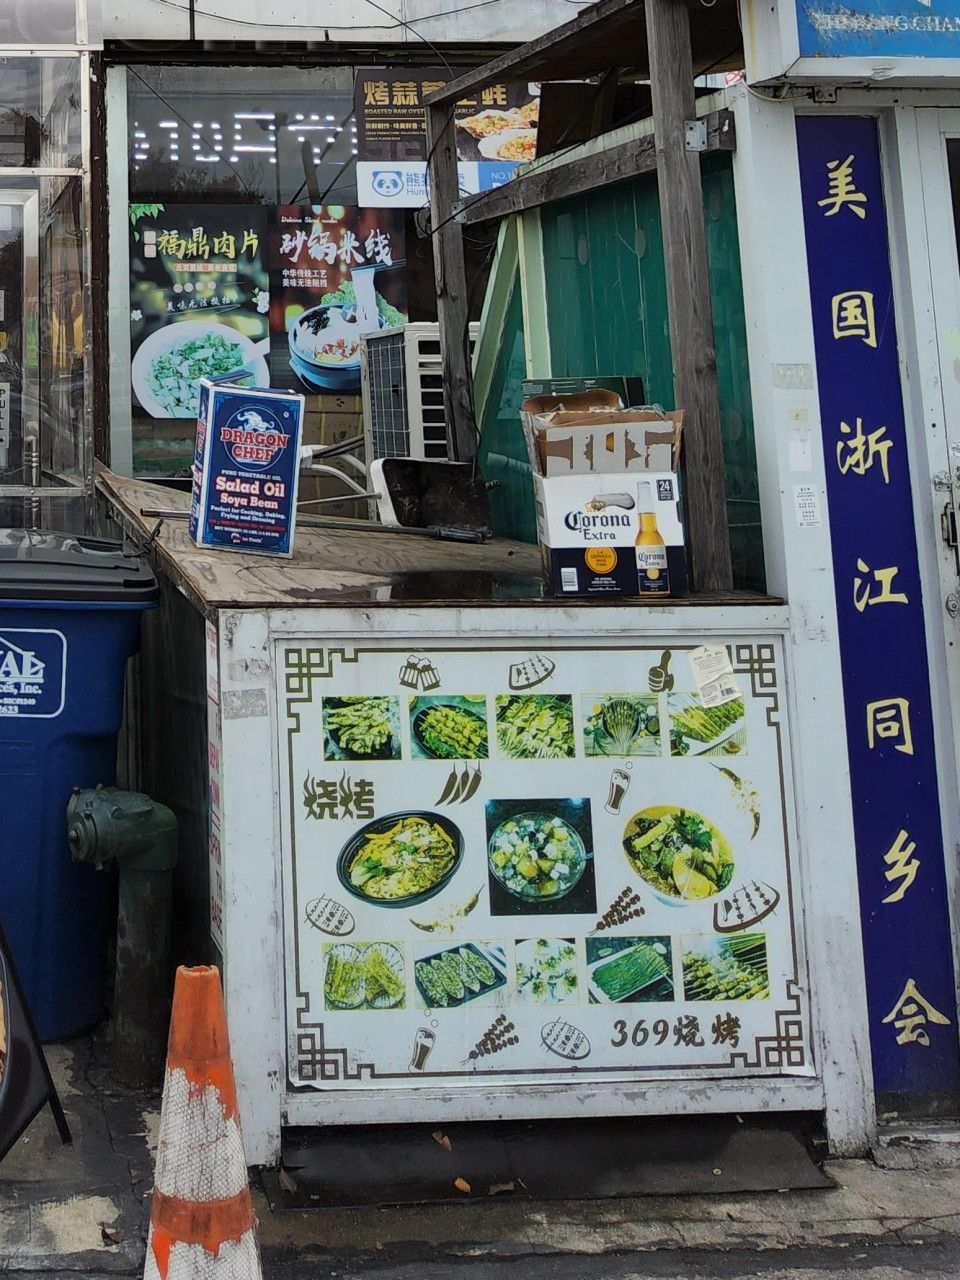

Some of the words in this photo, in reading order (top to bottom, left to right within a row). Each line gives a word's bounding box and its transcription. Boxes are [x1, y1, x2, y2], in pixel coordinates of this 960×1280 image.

[157, 226, 259, 260] 福鼎肉片
[279, 228, 393, 266] 砂锅米线
[221, 428, 289, 448] DRAGON
[231, 446, 274, 461] CHEF
[215, 476, 260, 495] Salad
[263, 482, 285, 498] Oil
[659, 480, 670, 491] 24
[220, 493, 248, 507] Soya
[249, 496, 279, 510] Bean
[564, 510, 631, 534] Corona
[583, 528, 617, 541] Extra
[638, 551, 665, 562] Corona
[817, 153, 951, 1047] 美国浙江同乡会
[20, 682, 42, 694] Inc.
[303, 768, 375, 821] 烧烤
